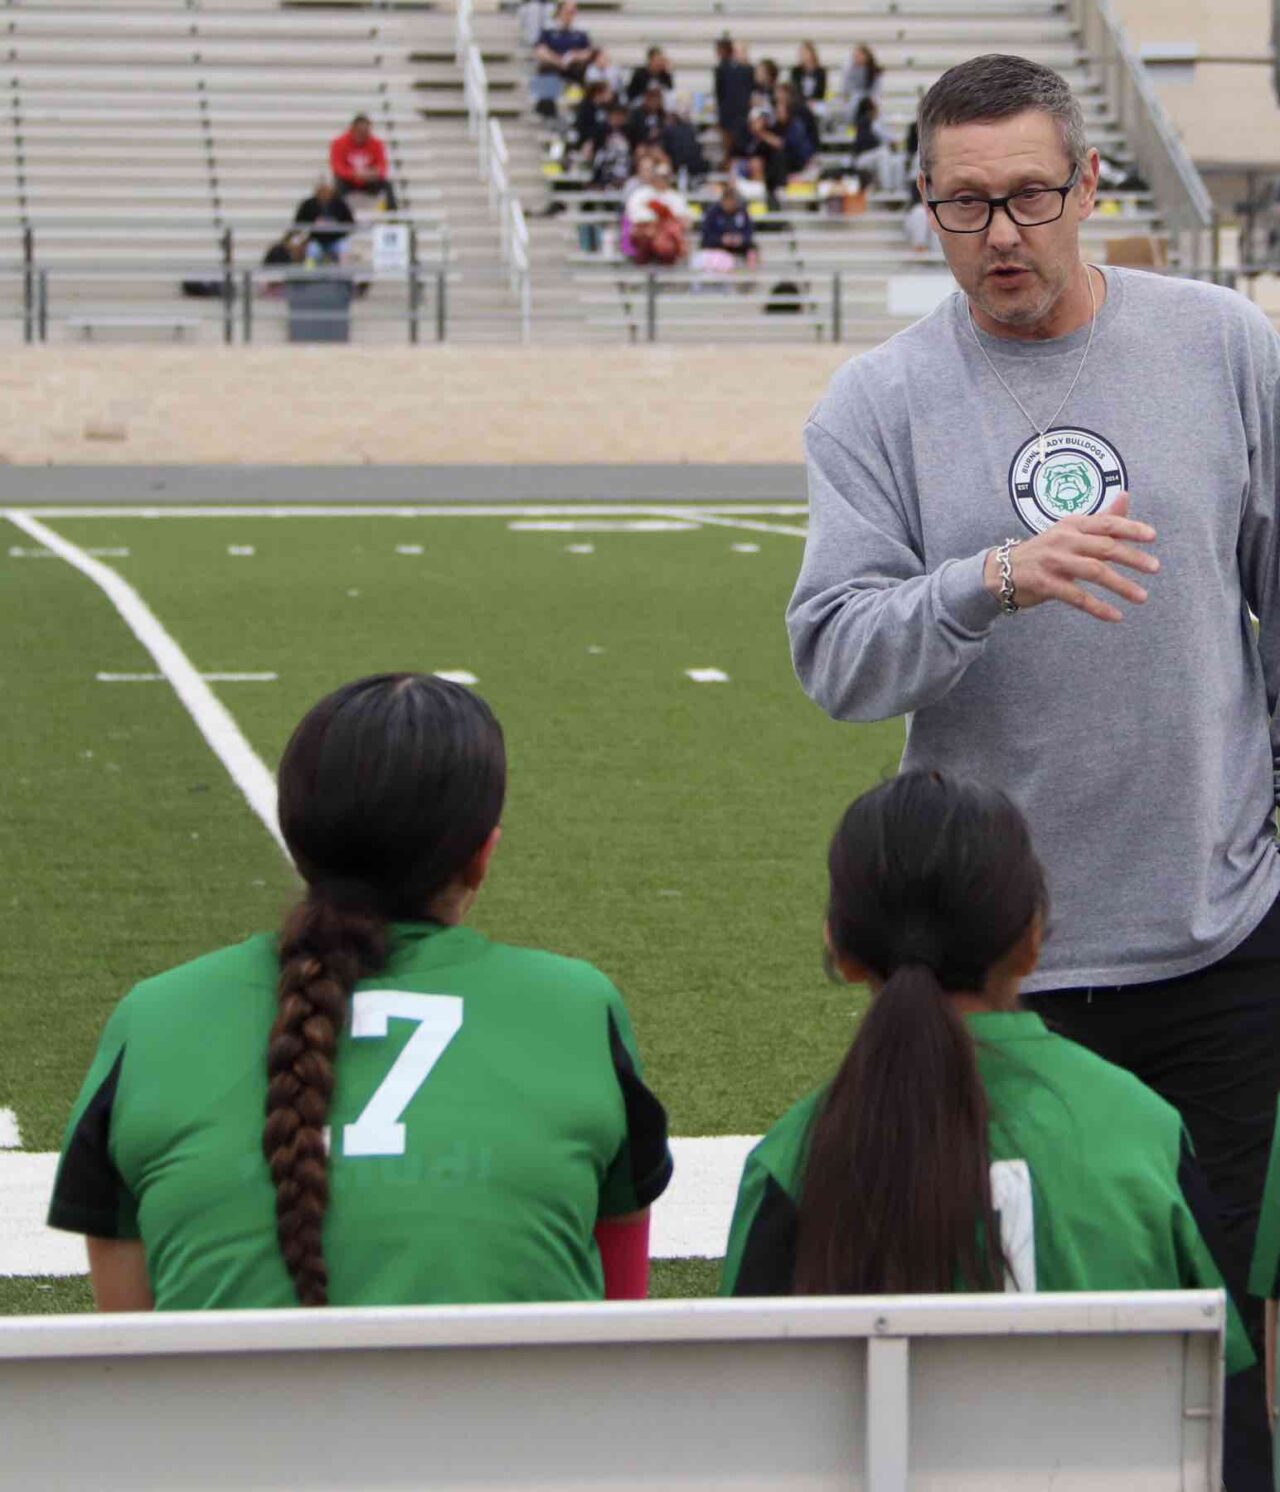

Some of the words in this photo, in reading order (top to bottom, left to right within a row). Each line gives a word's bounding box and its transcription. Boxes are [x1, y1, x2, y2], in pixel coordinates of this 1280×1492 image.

[1021, 446, 1041, 474] BURN
[1044, 437, 1064, 448] ADY
[1065, 437, 1106, 460] BULLDOGS
[1067, 500, 1075, 510] B
[322, 989, 464, 1157] 7
